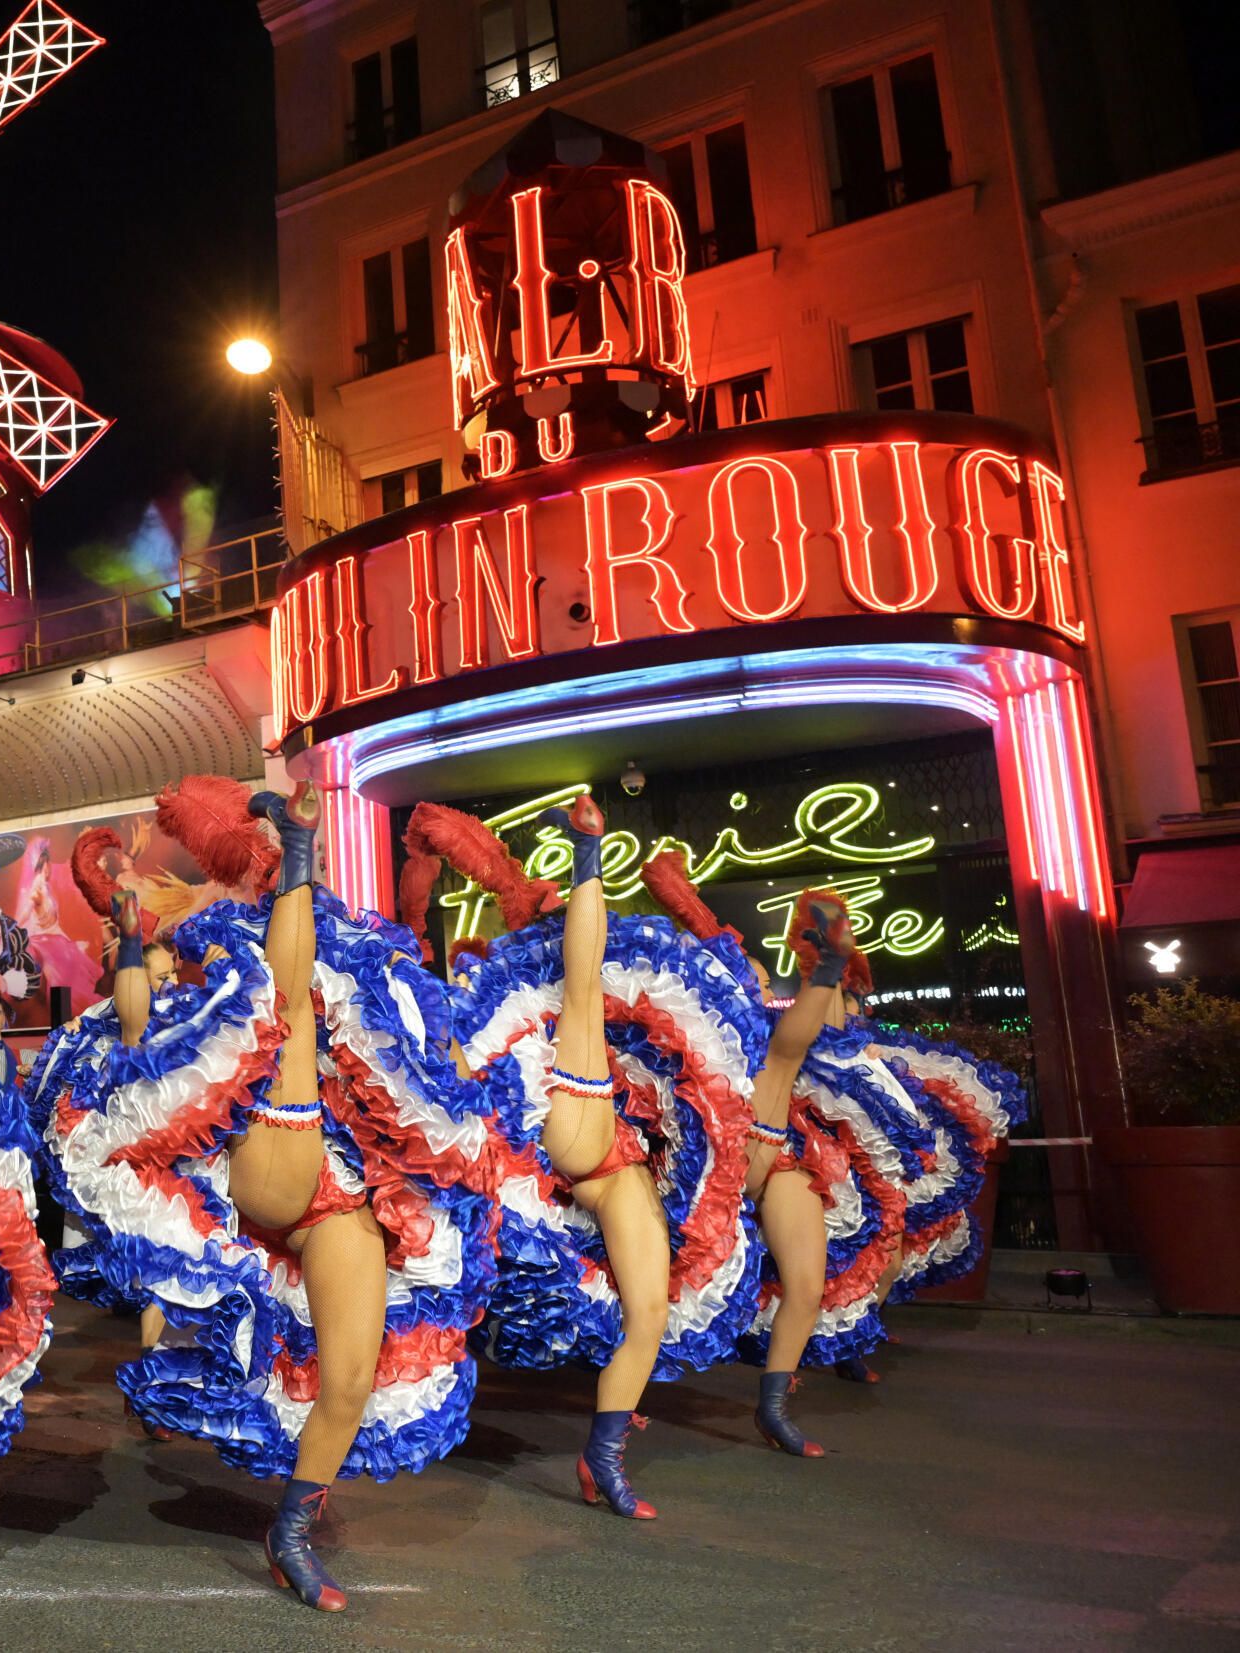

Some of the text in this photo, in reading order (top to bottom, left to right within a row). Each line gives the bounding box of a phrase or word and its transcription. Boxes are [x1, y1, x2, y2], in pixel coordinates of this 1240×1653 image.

[480, 413, 575, 479] DU
[270, 441, 1087, 741] OULIN ROUGE
